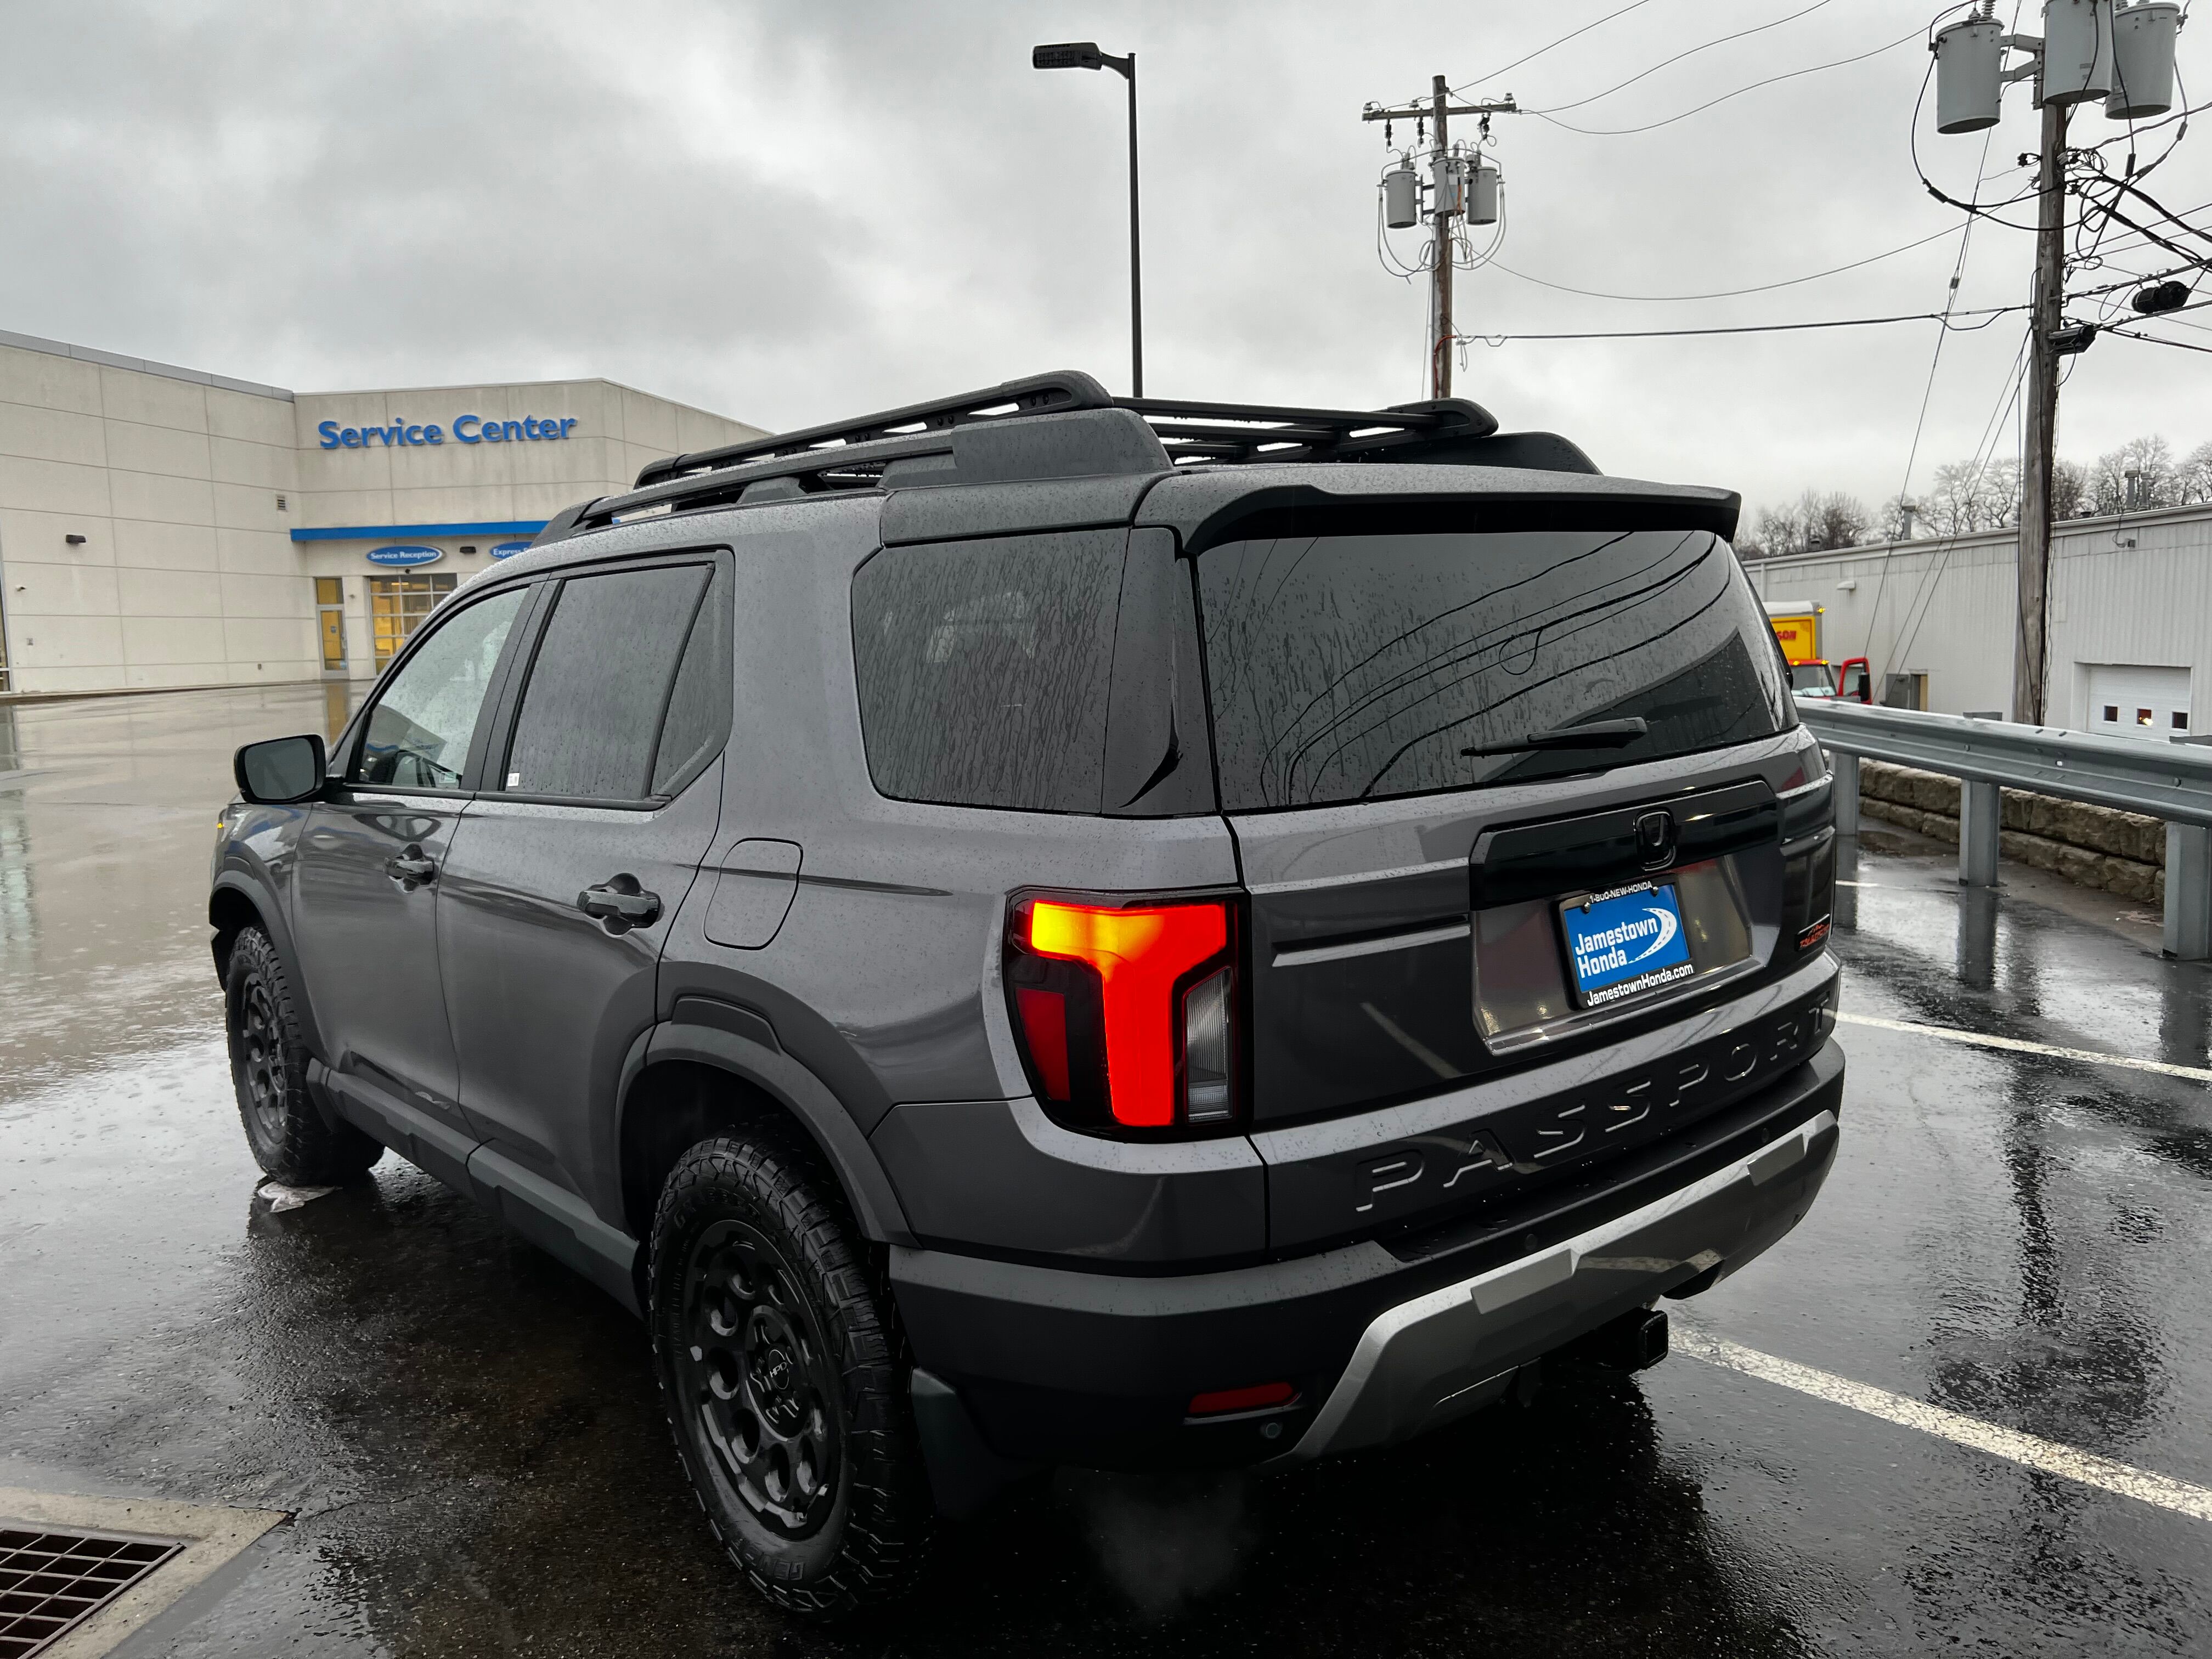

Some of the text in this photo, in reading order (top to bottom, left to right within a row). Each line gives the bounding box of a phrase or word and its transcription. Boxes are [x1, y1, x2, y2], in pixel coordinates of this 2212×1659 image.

[318, 414, 578, 449] Service Center
[399, 551, 437, 559] Reception
[1589, 881, 1652, 904] 1-800-NEW-HONDA
[1575, 917, 1658, 956] Jamestown
[1577, 948, 1627, 979] Honda
[1587, 963, 1694, 1007] JamestownHonda.com
[1355, 990, 1830, 1212] PASSPORT
[769, 1362, 787, 1378] HPD
